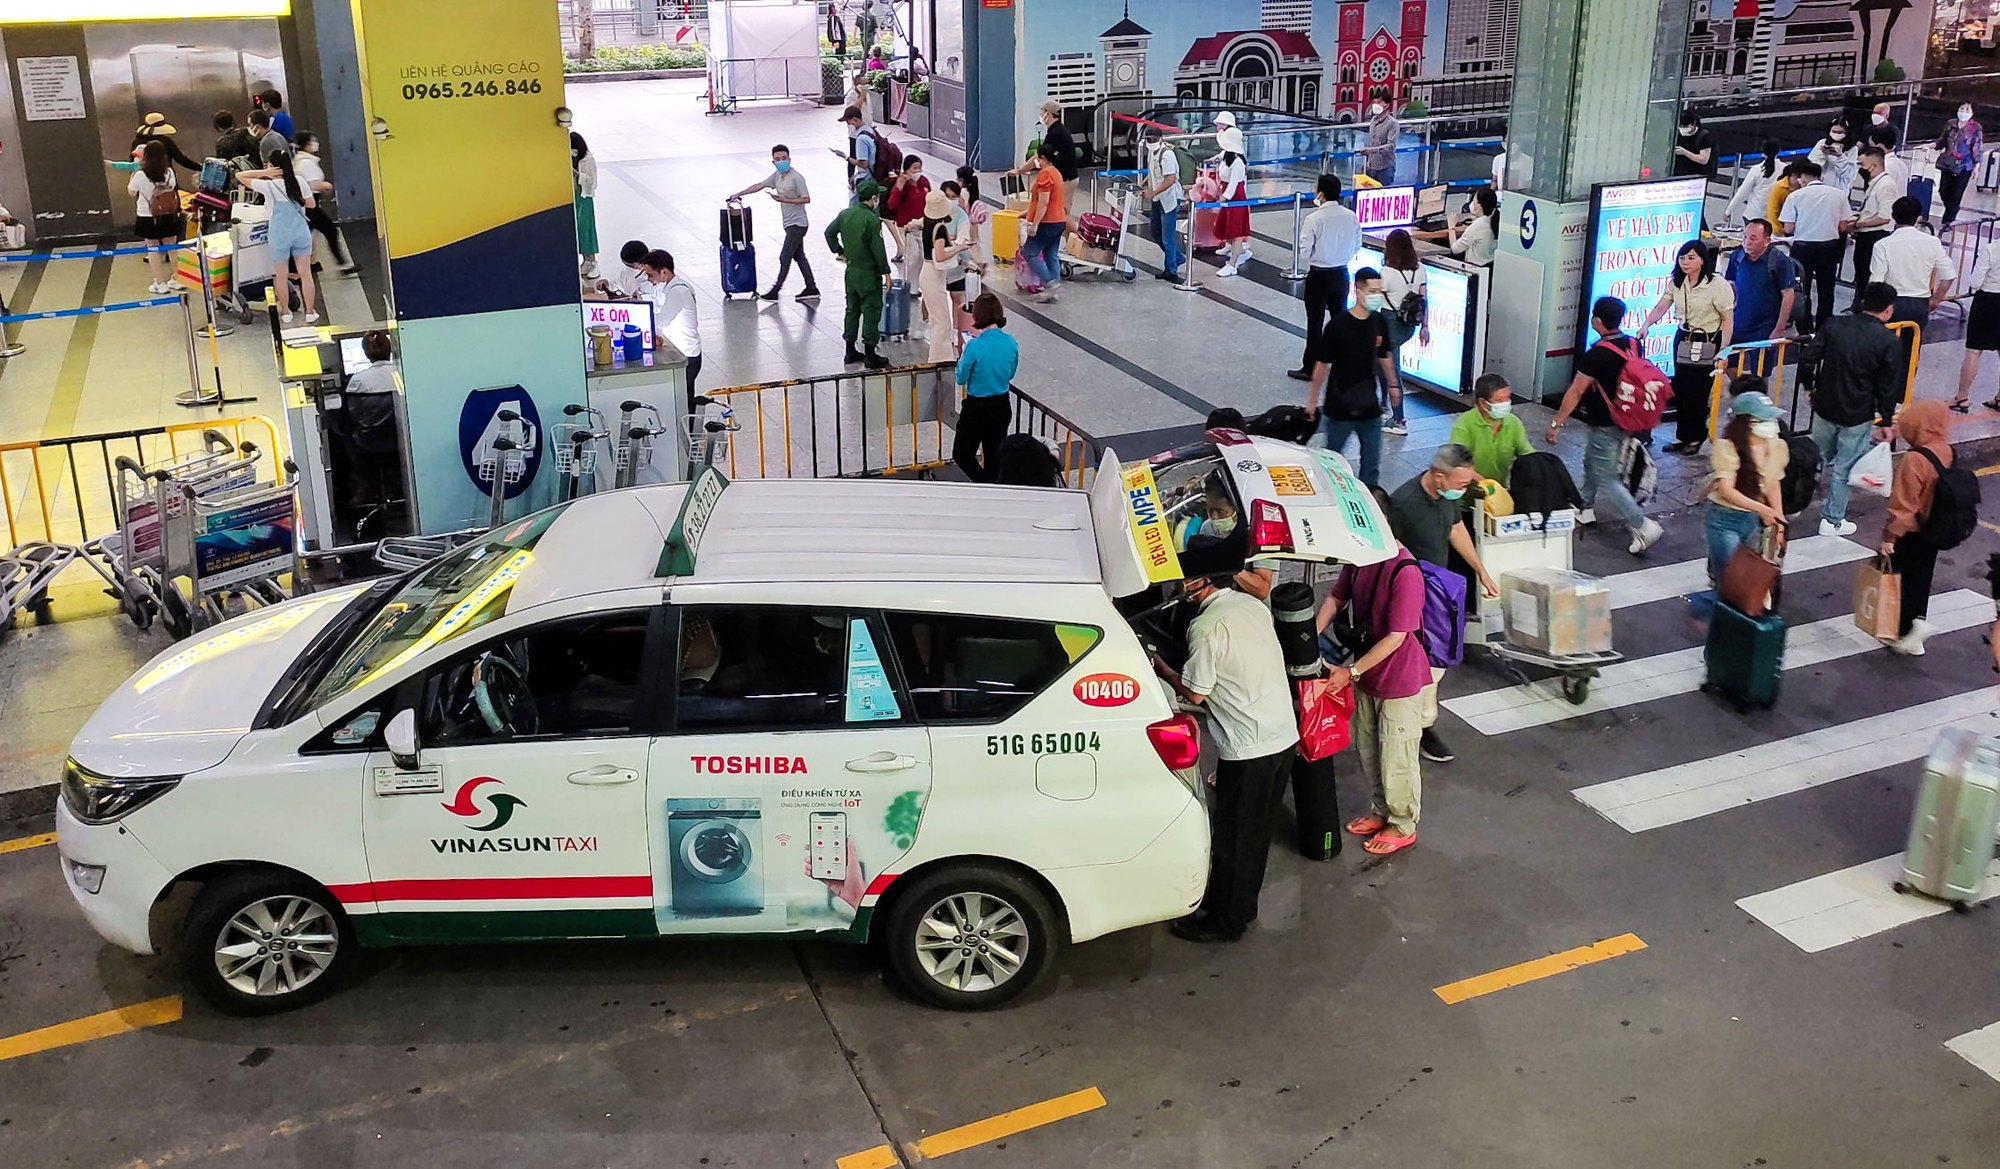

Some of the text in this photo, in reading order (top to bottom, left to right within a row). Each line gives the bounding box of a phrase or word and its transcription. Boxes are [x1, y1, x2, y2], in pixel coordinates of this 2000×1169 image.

[400, 65, 427, 79] LIÊN
[452, 61, 504, 77] QUẢNG
[508, 60, 540, 74] CÁO
[402, 78, 542, 100] 0965.246.846
[1371, 192, 1393, 222] MÁY
[1393, 194, 1412, 220] BAY
[1522, 209, 1535, 240] 3
[1608, 210, 1695, 238] VÉ MÁY BAY
[1598, 248, 1648, 270] TRONG
[591, 306, 630, 322] XE ÔM
[1129, 486, 1159, 527] MPE
[1144, 527, 1161, 545] LED
[1079, 680, 1135, 700] 10406
[986, 731, 1101, 755] 51G 65004
[690, 756, 808, 774] TOSHIBA
[844, 799, 862, 807] IoT
